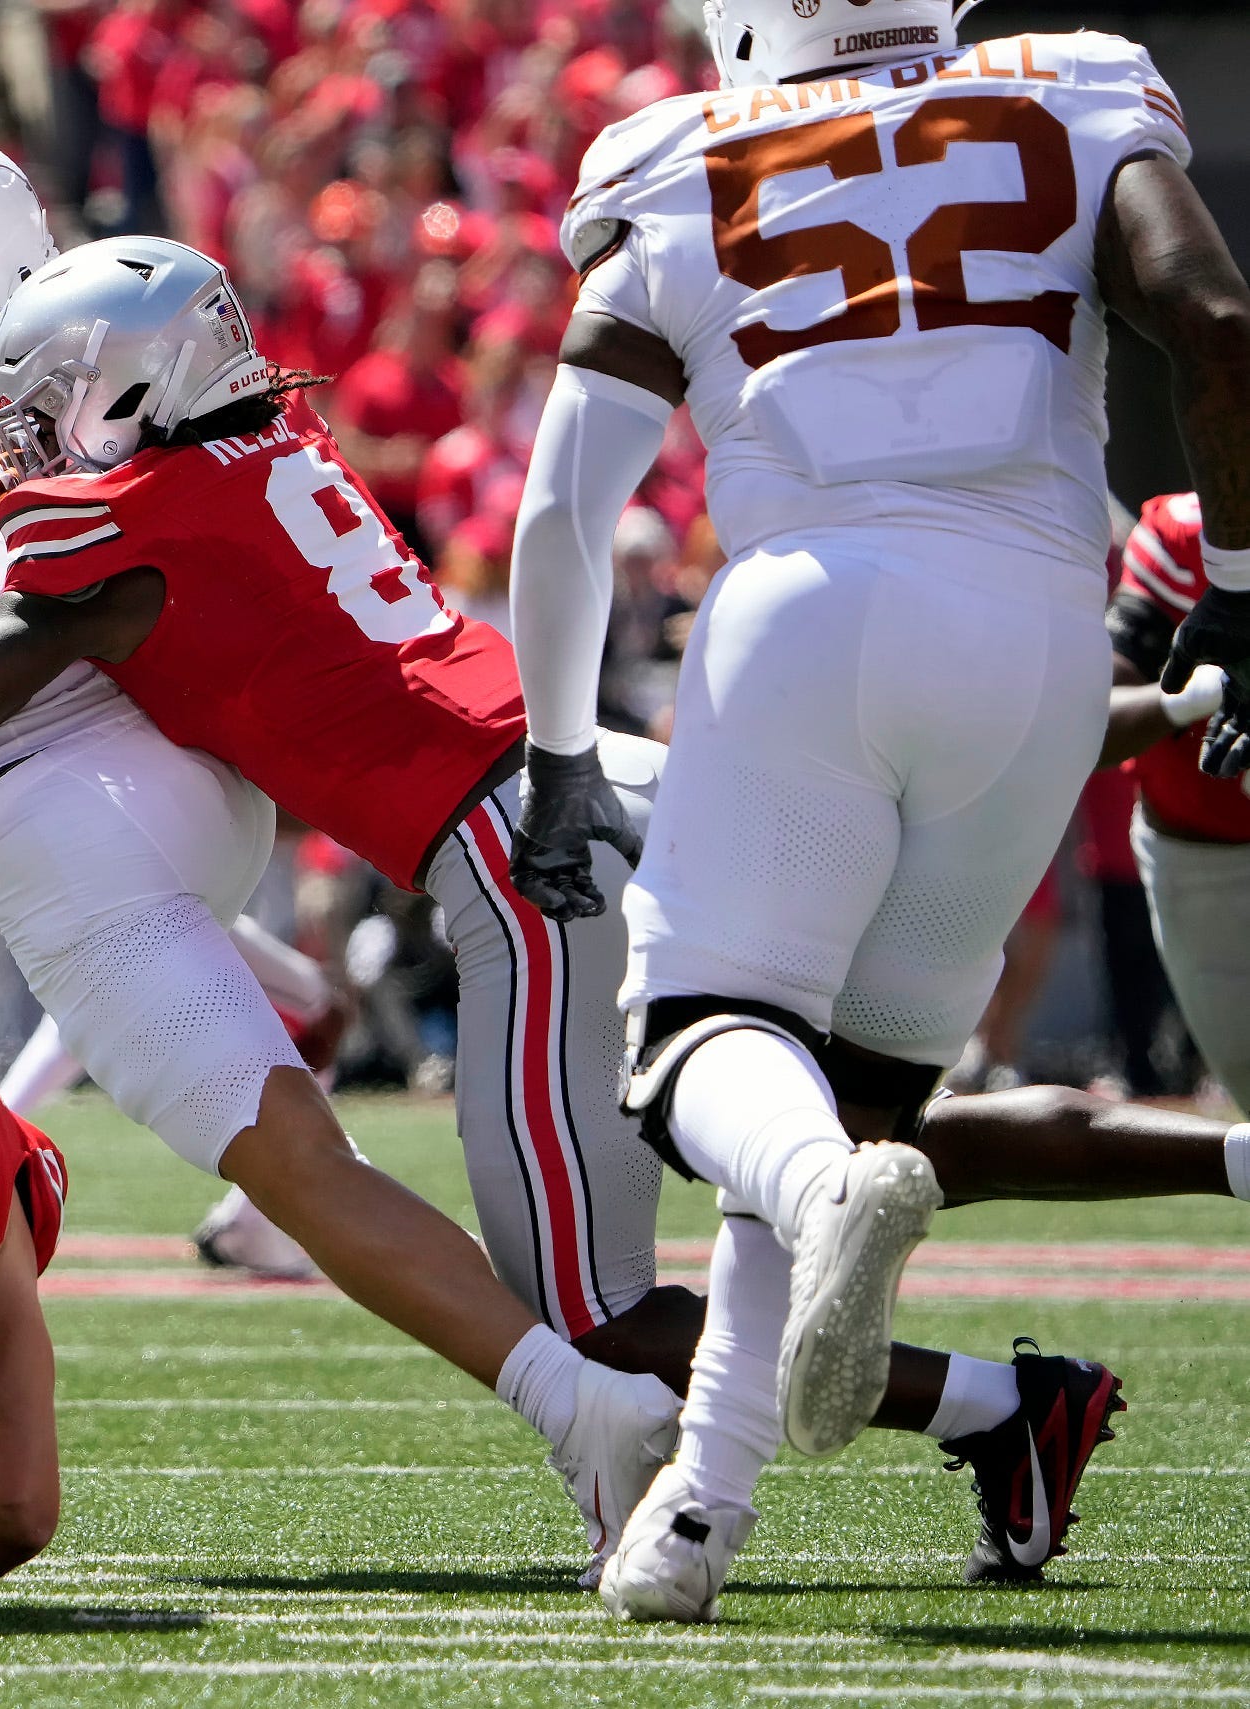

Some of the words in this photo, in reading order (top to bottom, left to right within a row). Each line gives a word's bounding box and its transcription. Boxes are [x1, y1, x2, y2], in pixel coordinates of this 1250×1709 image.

[833, 26, 939, 57] LONGHORNS
[702, 95, 1081, 371] 52
[230, 323, 242, 343] 8
[264, 446, 456, 645] 8
